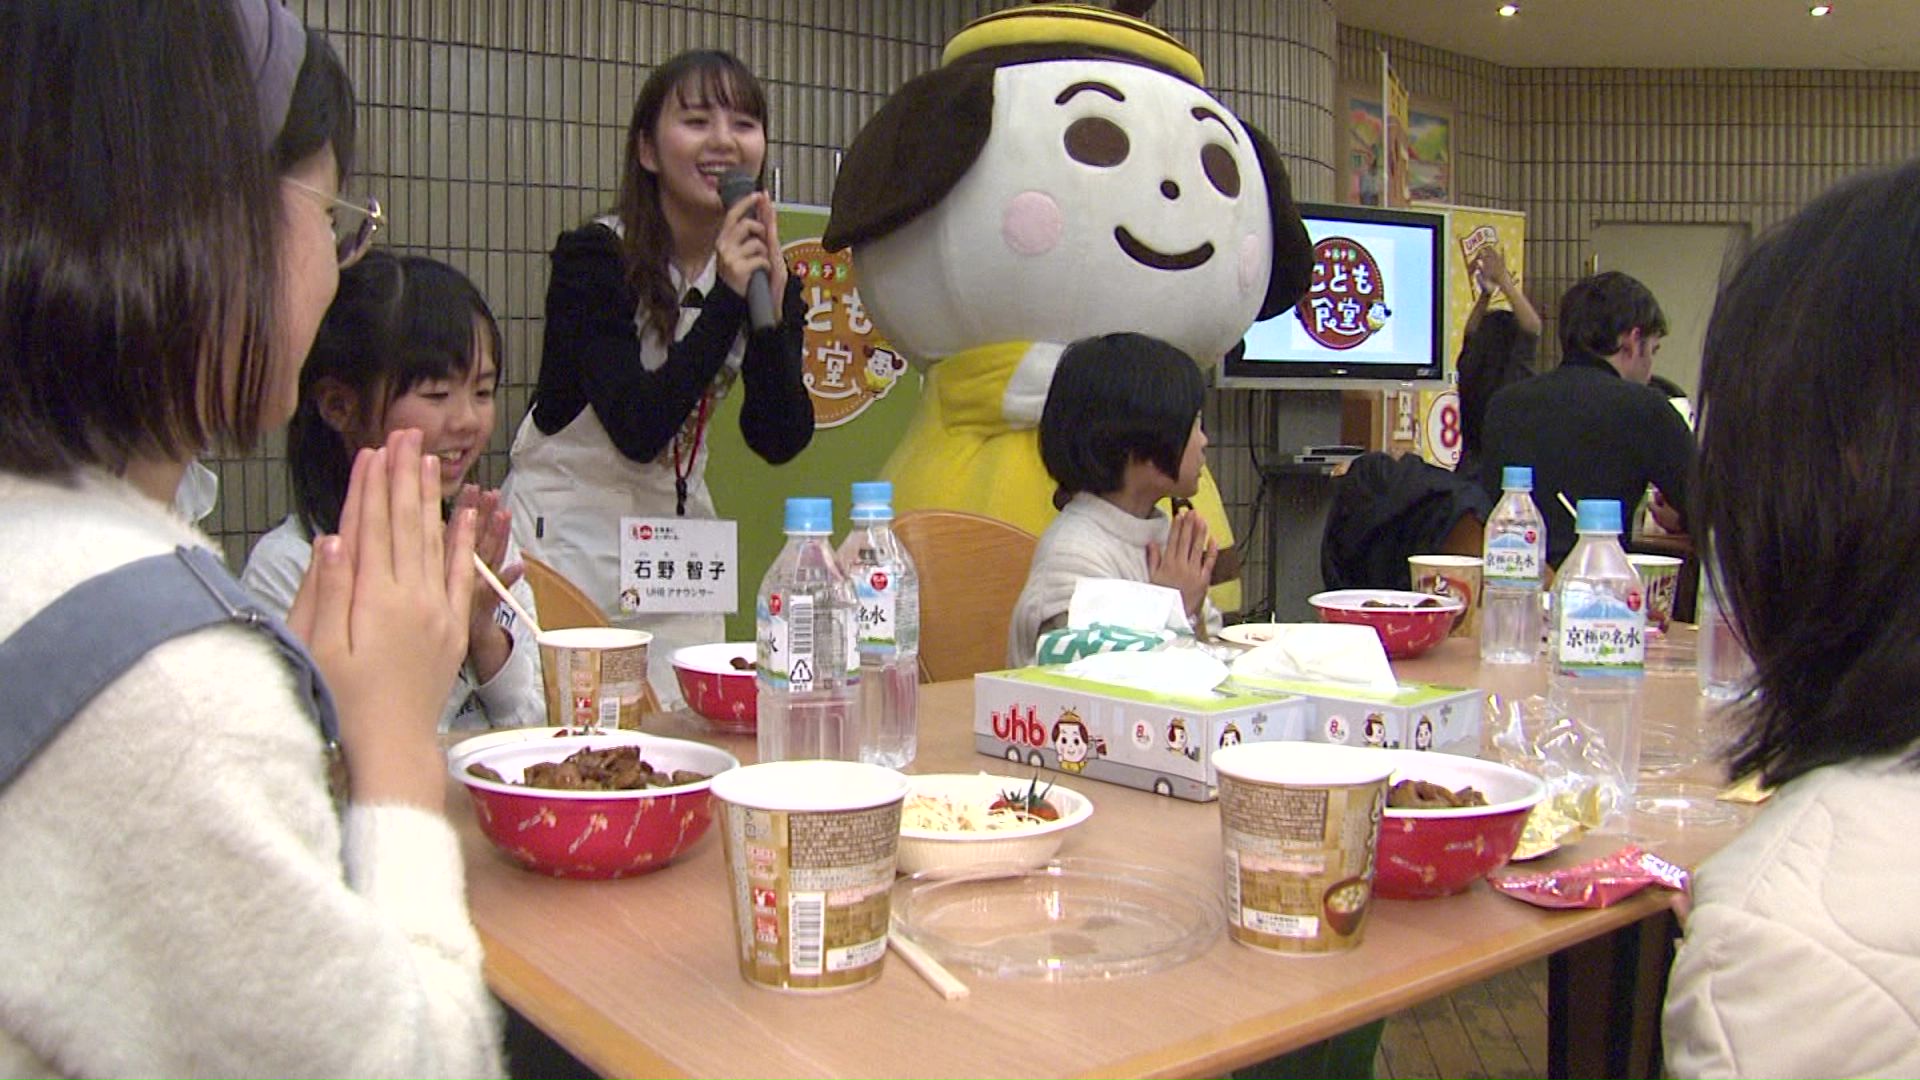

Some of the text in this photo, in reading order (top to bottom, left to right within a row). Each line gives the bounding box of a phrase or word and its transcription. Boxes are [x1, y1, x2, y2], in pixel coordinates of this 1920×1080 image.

[1310, 264, 1373, 295] こども
[804, 286, 873, 334] ども
[1312, 297, 1364, 335] 食堂
[1441, 405, 1459, 448] 8
[634, 560, 726, 580] 石野 智子
[667, 587, 715, 598] アナウンサー
[1565, 624, 1641, 648] 京極の名水
[991, 704, 1046, 748] uhb
